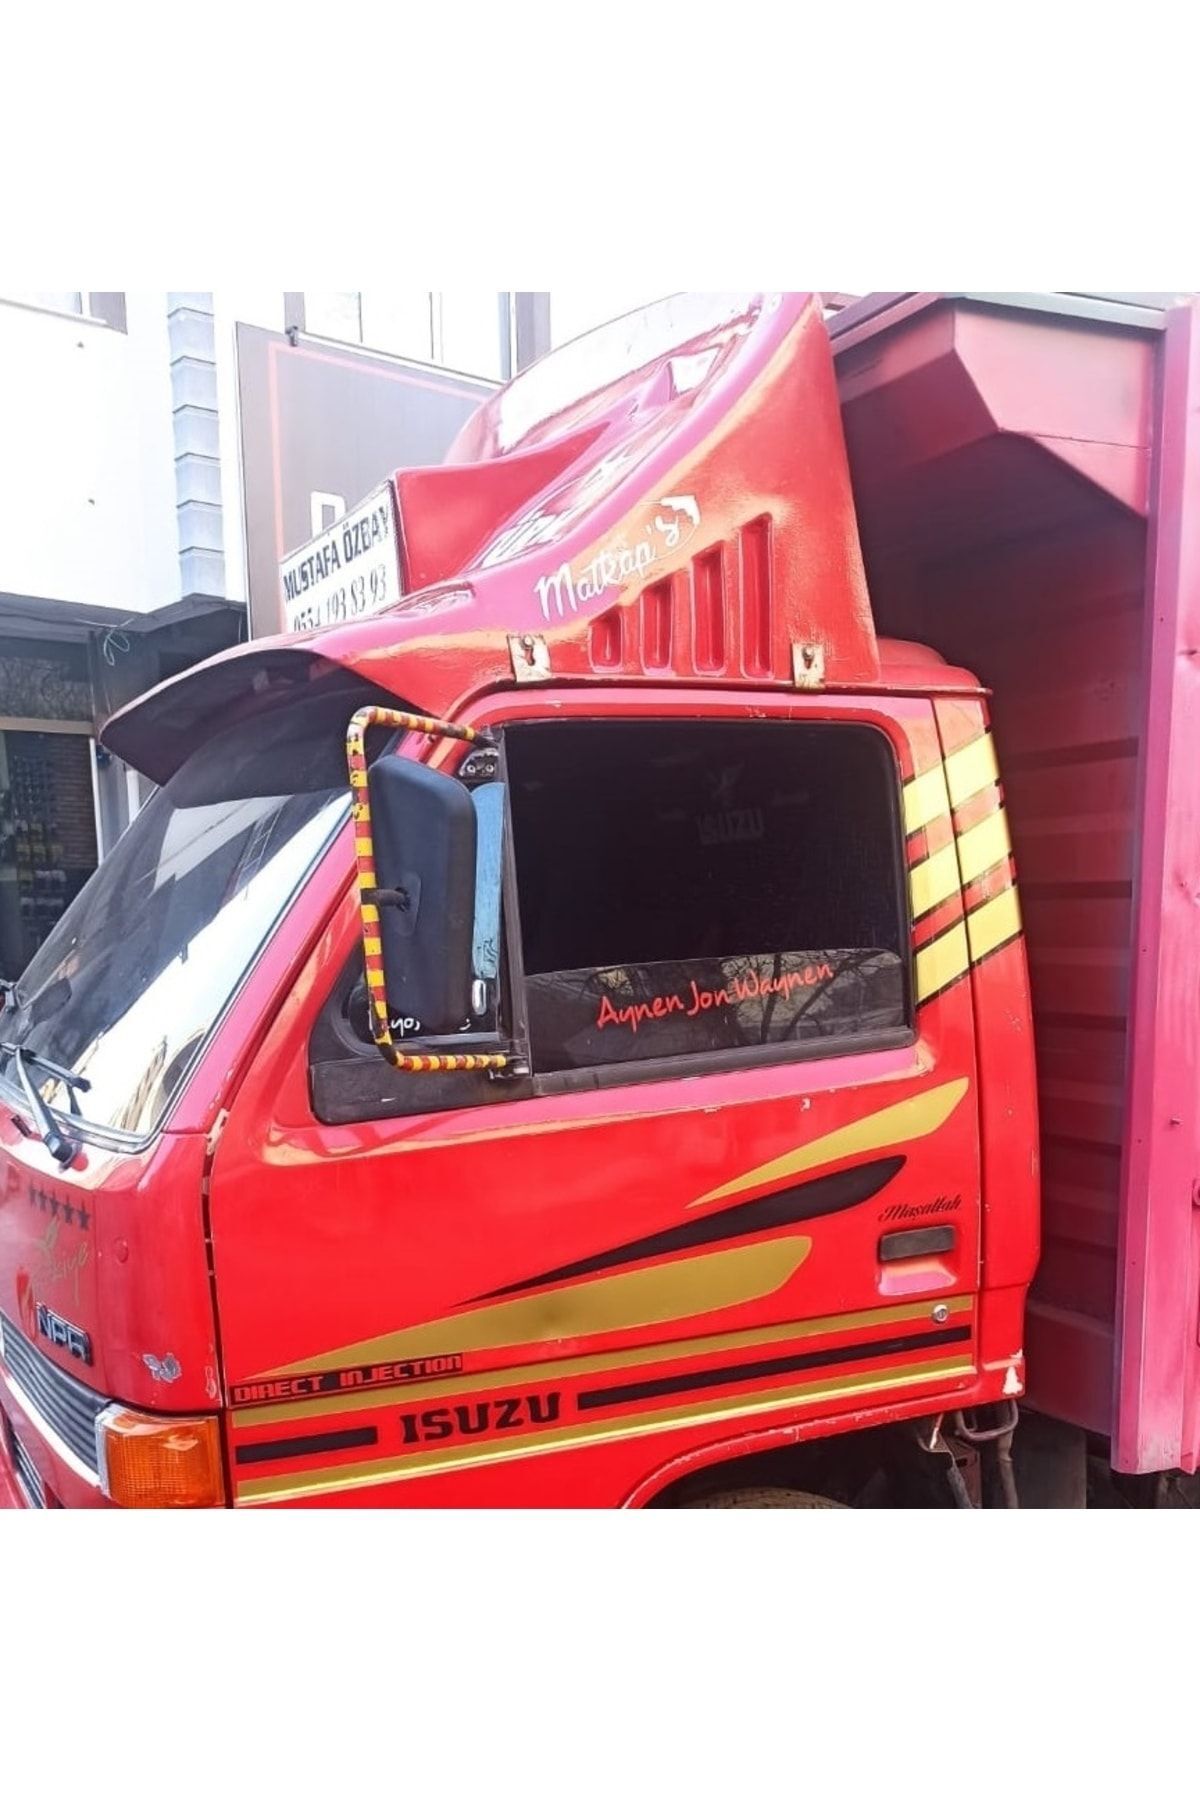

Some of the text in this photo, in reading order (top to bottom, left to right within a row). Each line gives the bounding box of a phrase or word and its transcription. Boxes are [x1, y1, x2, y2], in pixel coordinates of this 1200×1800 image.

[283, 539, 342, 602] MUSTAFA
[342, 506, 390, 563] ÖZBAY
[326, 588, 346, 624] 193
[350, 575, 366, 616] 83
[369, 564, 387, 602] 93
[597, 961, 834, 1033] Aynen Jon Waynen
[36, 1300, 94, 1367] NPR
[233, 1354, 462, 1404] DIRECT INJECTION
[400, 1391, 561, 1444] ISUZU
